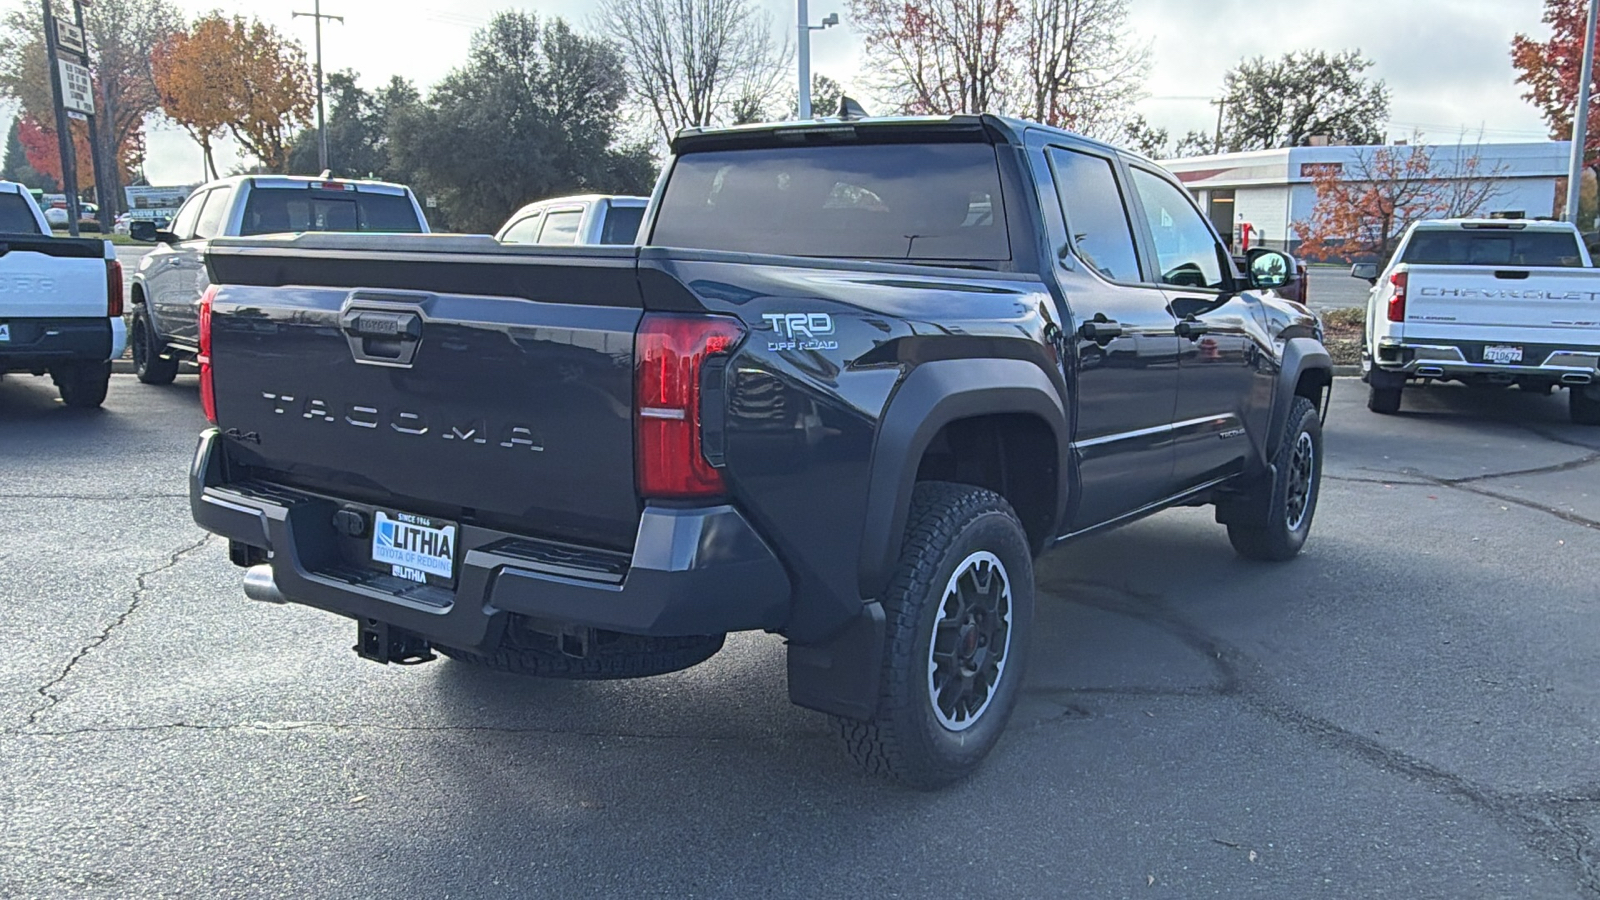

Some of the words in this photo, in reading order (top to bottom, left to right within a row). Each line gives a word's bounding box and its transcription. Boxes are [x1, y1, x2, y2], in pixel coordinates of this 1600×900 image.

[1421, 287, 1600, 301] CHEVROLET
[361, 320, 396, 333] TOYOTA
[761, 312, 835, 341] TRD
[261, 391, 544, 452] TACOMA
[398, 513, 415, 524] SINCE
[393, 524, 452, 559] LITHIA
[376, 546, 403, 560] TOYOTA
[405, 550, 416, 563] OF
[417, 555, 451, 571] REDDING
[400, 565, 427, 584] LITHIA
